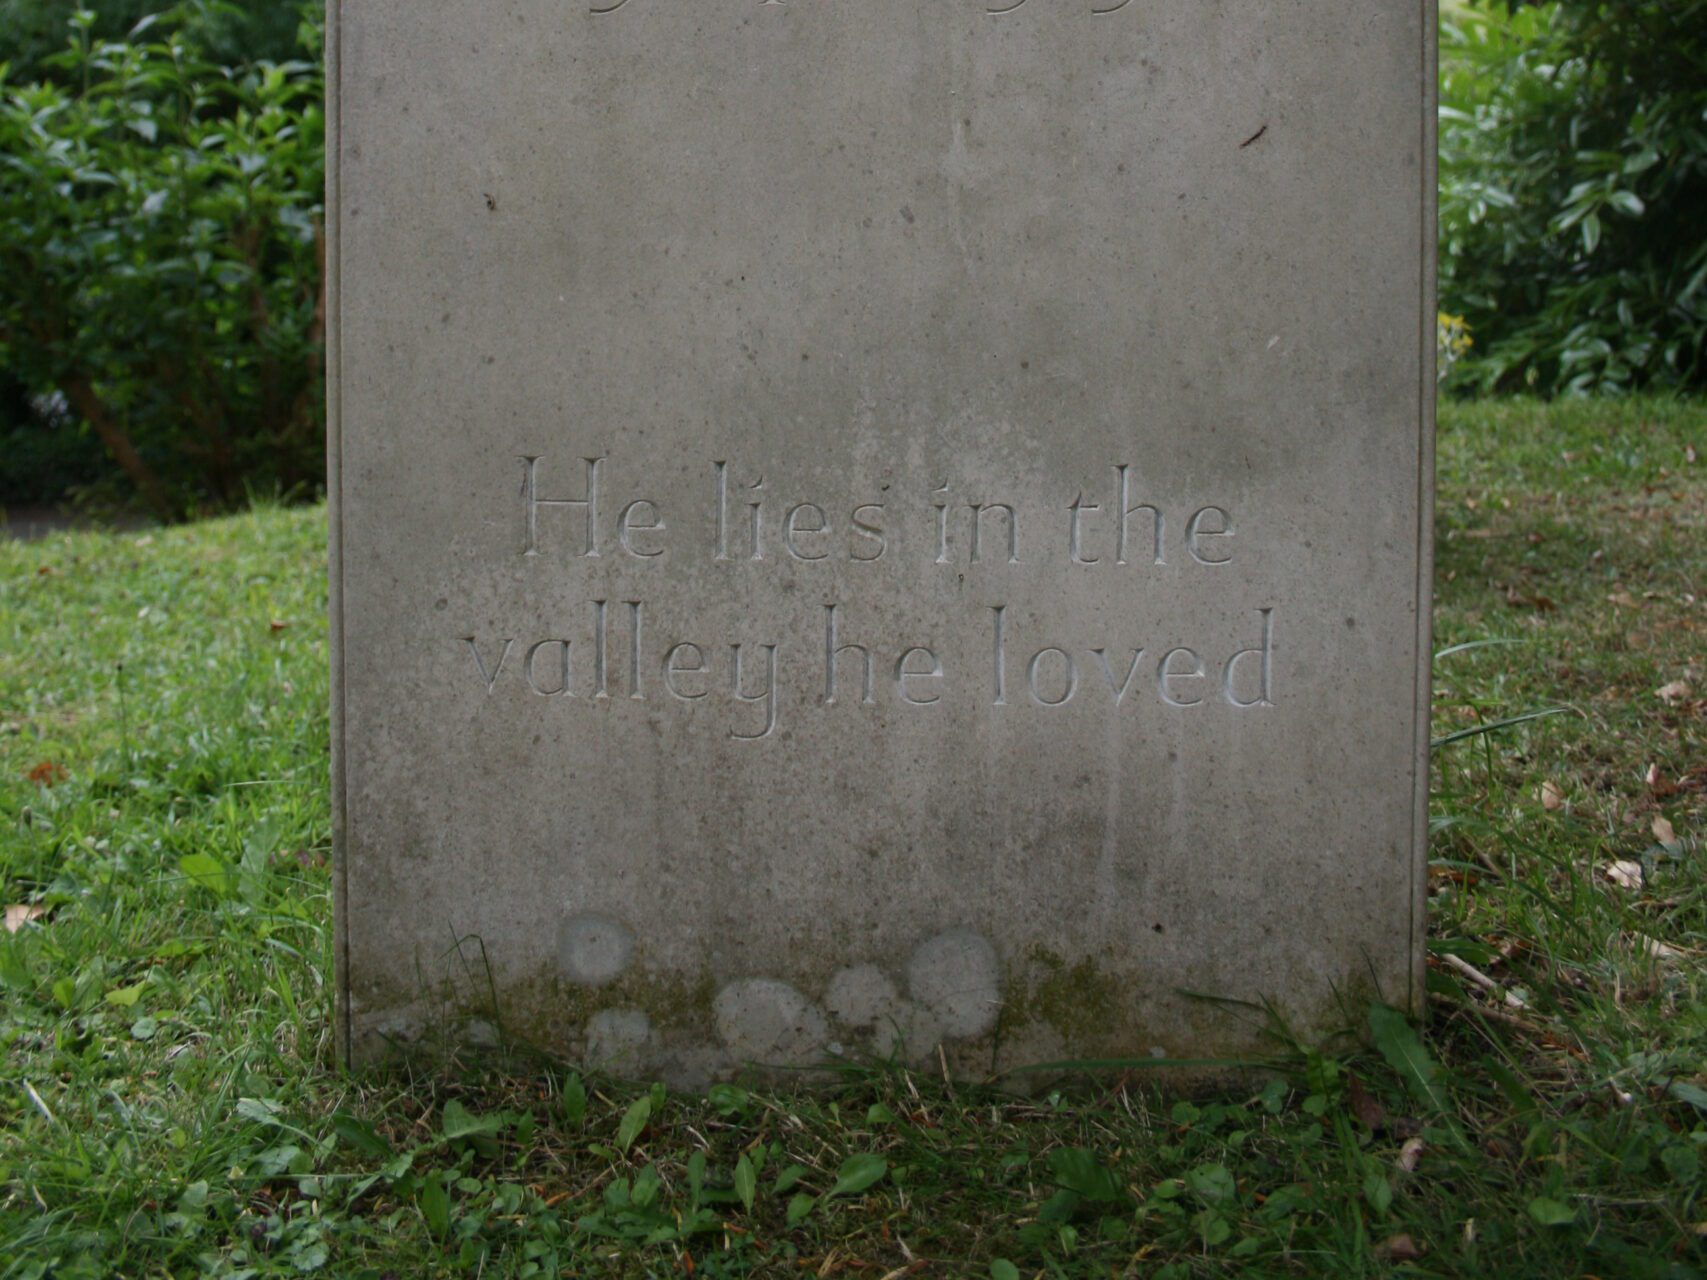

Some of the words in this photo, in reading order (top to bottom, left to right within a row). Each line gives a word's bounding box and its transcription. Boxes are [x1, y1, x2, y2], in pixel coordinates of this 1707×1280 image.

[515, 455, 667, 558] He
[711, 459, 890, 562] lies
[932, 477, 1021, 565] in
[1067, 463, 1237, 566] the
[456, 600, 778, 740] valley
[821, 603, 943, 706] he
[986, 606, 1277, 709] loved
